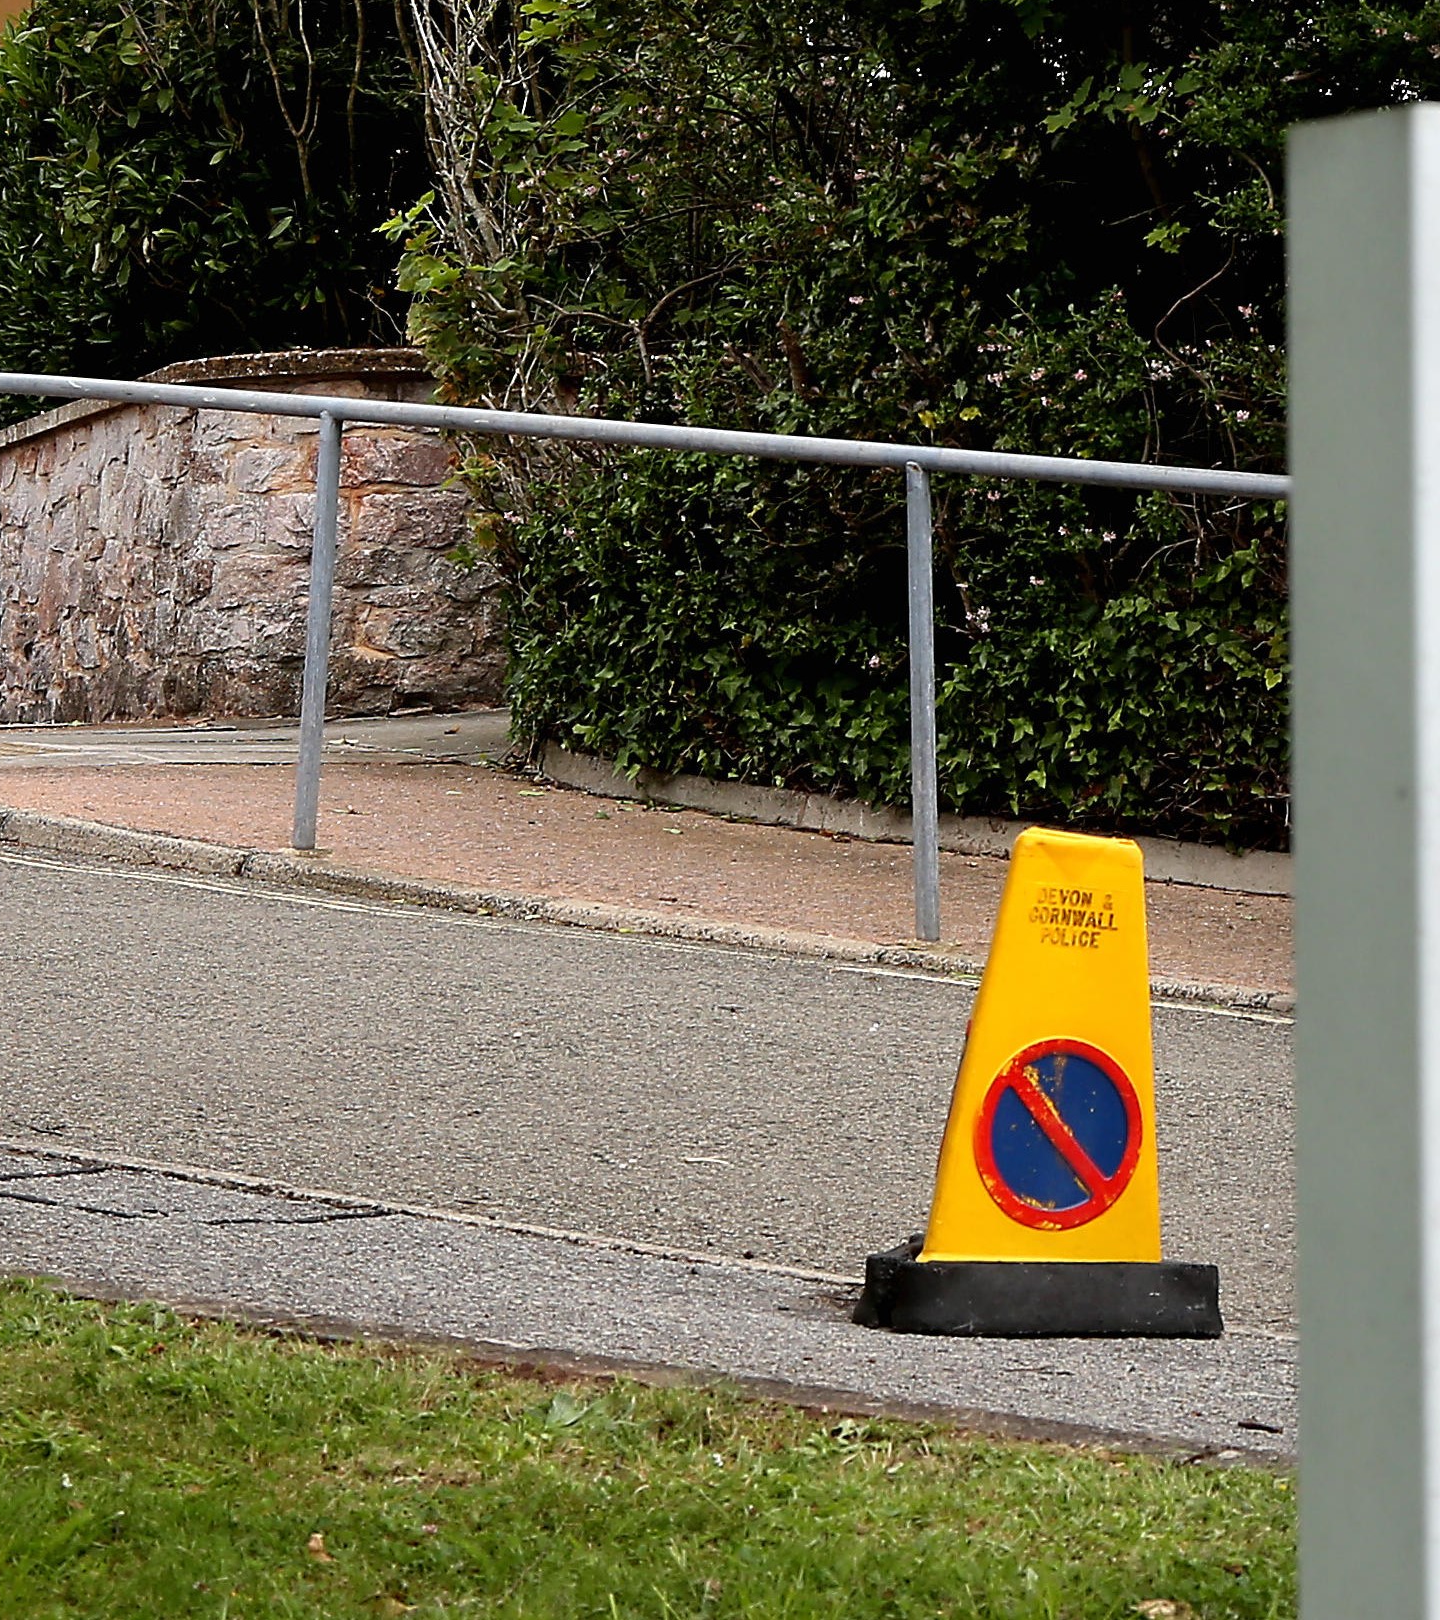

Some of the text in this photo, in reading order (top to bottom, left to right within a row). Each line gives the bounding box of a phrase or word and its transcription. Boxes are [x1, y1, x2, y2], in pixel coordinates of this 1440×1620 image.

[1037, 888, 1093, 907] DEVON
[1028, 906, 1118, 931] CORNWALL
[1040, 927, 1101, 949] POLICE
